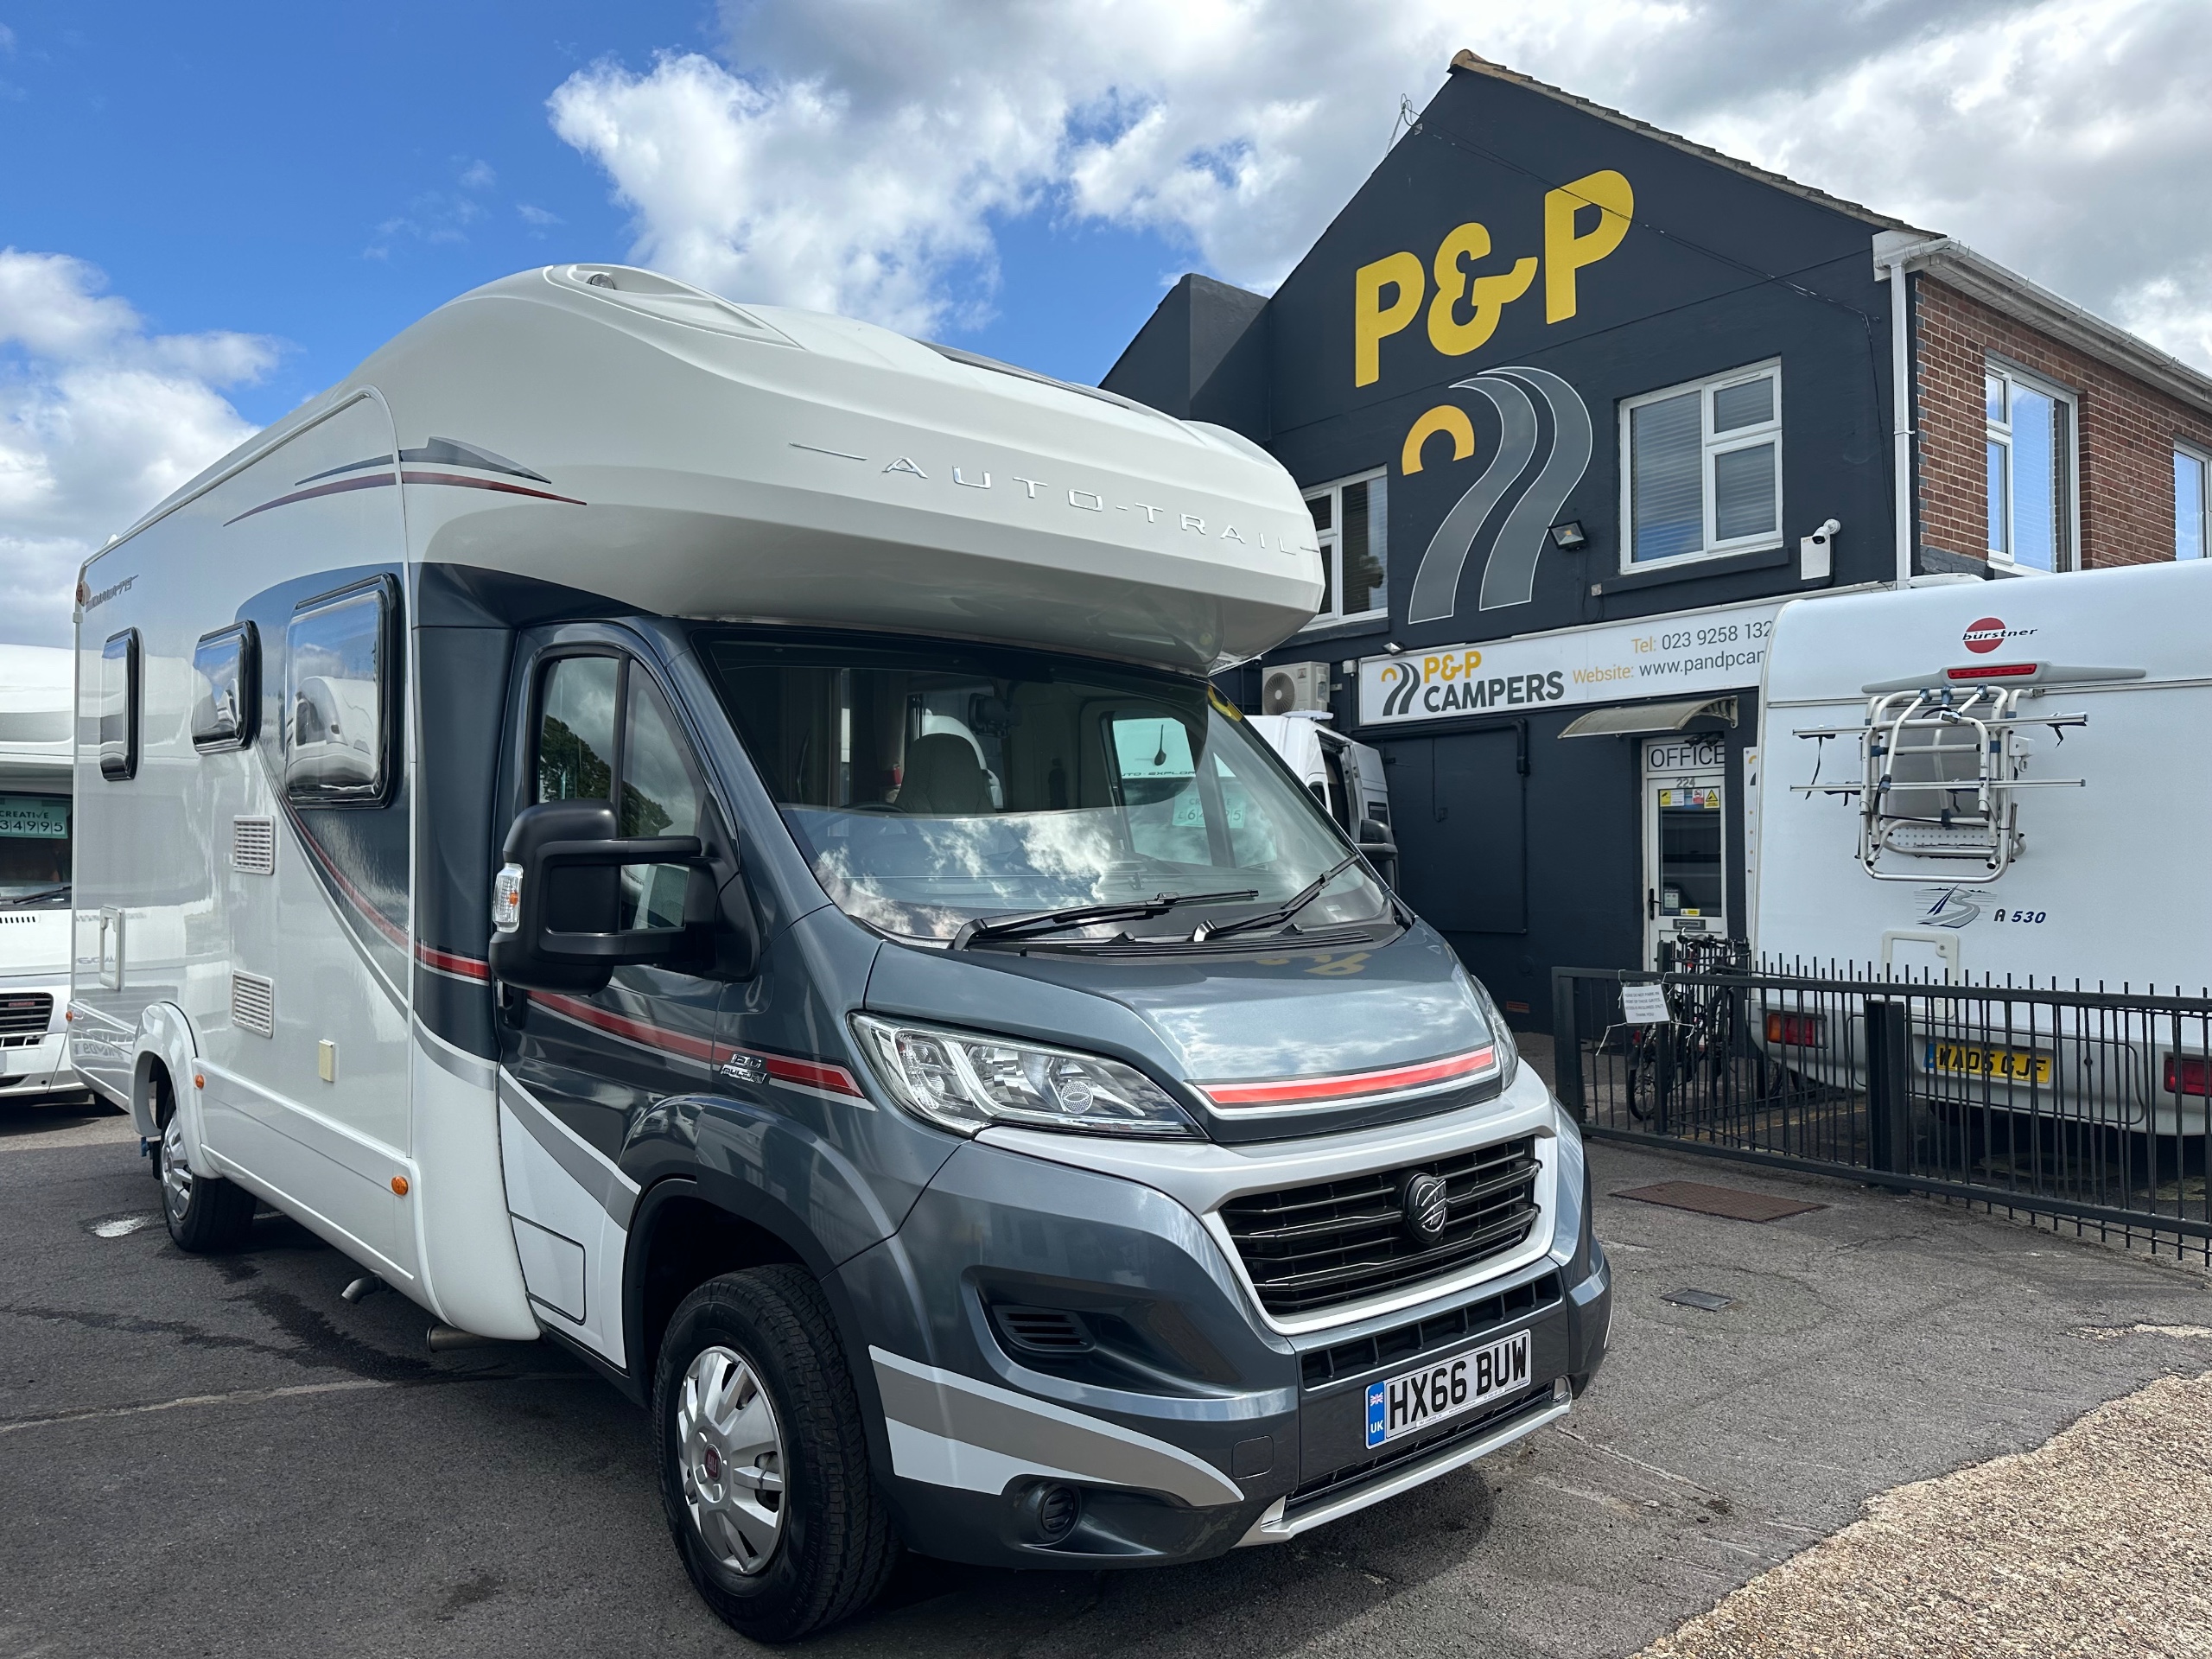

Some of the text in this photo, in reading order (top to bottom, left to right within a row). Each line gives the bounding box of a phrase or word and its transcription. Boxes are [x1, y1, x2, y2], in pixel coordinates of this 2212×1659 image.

[1356, 170, 1634, 388] P&P
[883, 456, 1296, 556] AUTO-TRAIL
[1631, 636, 1656, 654] Tel:
[1662, 632, 1692, 650] 023
[1697, 625, 1738, 645] 9258
[1962, 628, 2037, 640] bürstner
[1423, 651, 1482, 683] P&P
[1573, 664, 1634, 683] Website:
[1423, 671, 1565, 713] CAMPERS
[1650, 745, 1726, 767] OFFICE
[1676, 778, 1696, 788] 224
[0, 820, 63, 832] 34995
[1993, 908, 2047, 924] A 530
[1389, 1336, 1527, 1431] HX66 BUW
[1370, 1419, 1383, 1433] UK
